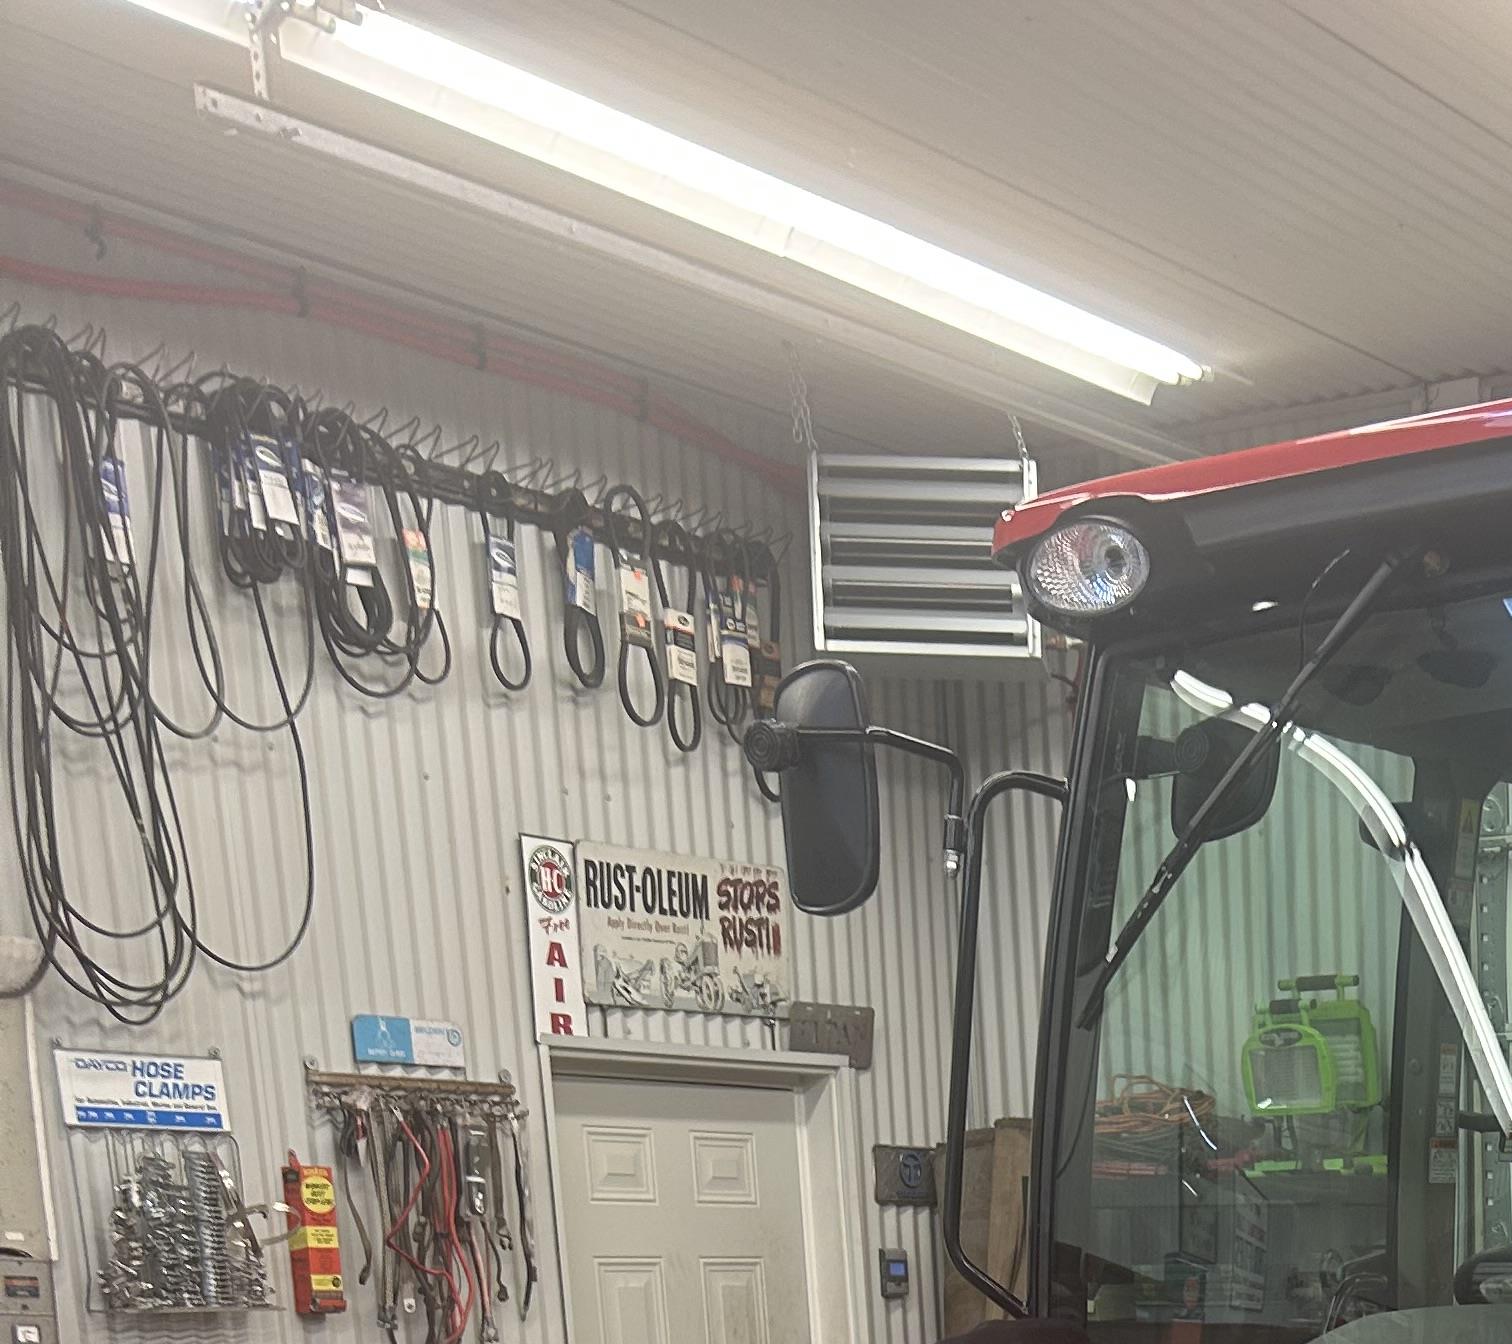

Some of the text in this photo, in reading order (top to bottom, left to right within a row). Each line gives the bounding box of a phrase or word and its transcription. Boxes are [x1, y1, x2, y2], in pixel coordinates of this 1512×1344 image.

[584, 858, 710, 921] RUST-OLEUM
[717, 877, 781, 914] STOPS
[75, 1057, 185, 1080] DAYCO HOSE
[135, 1080, 217, 1101] CLAMPS
